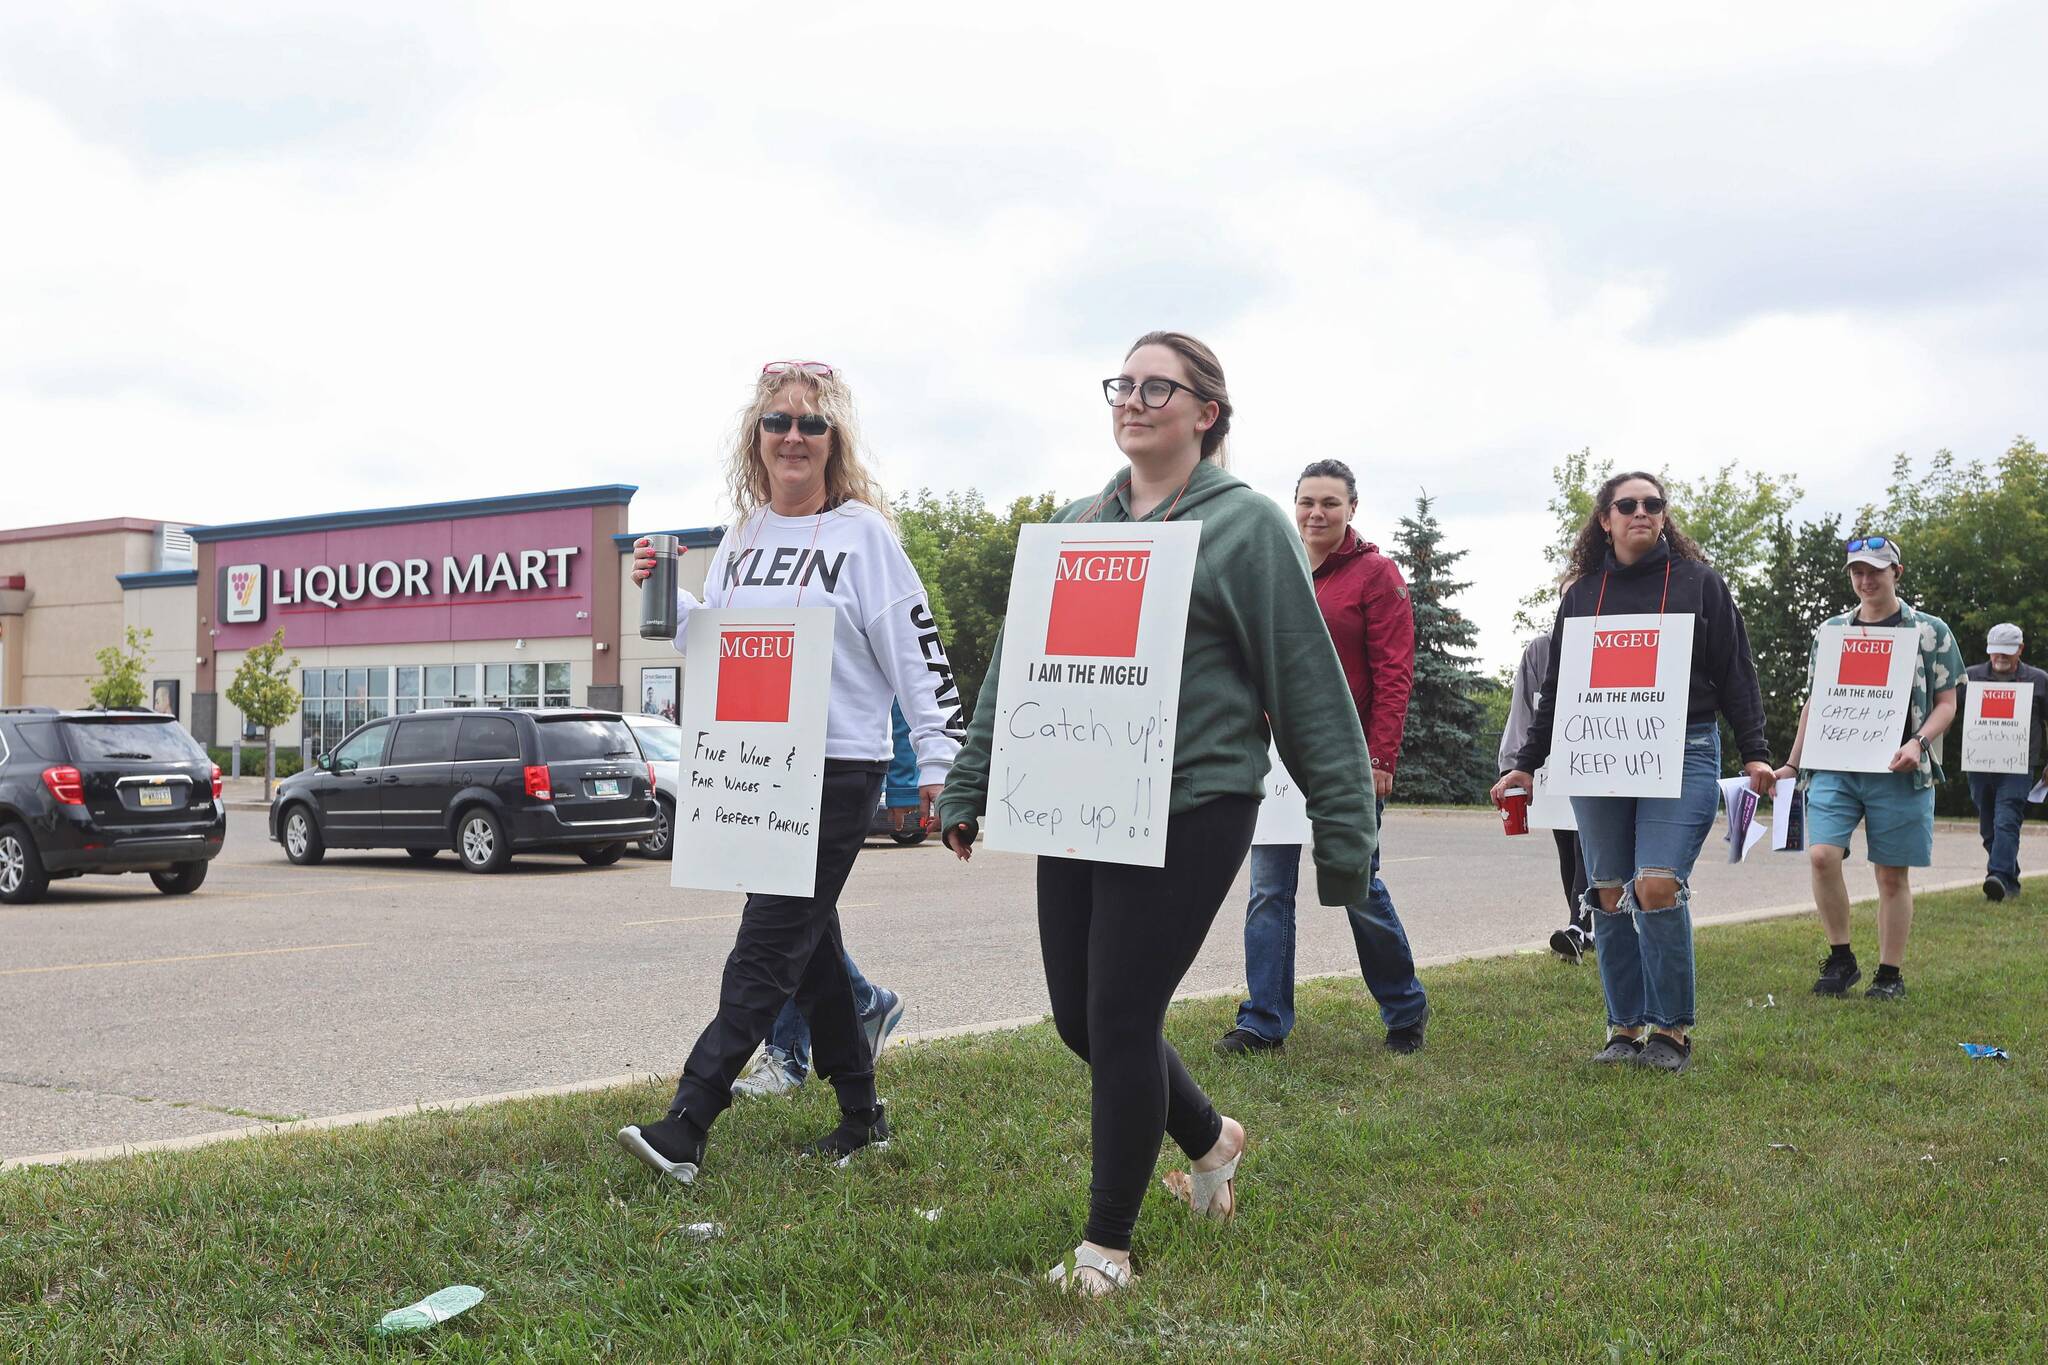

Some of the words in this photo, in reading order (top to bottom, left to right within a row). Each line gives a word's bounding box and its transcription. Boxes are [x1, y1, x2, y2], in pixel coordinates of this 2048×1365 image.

[272, 558, 431, 609] LIQUOR
[442, 546, 579, 595] MART
[722, 547, 847, 594] KLEIN
[1055, 555, 1150, 582] MGEU
[719, 636, 793, 659] MGEU
[1593, 632, 1660, 649] MGEU
[1842, 640, 1894, 654] MGEU
[910, 604, 968, 747] JEAN
[1028, 662, 1034, 682] I
[1037, 663, 1062, 683] AM
[1067, 664, 1096, 684] THE
[1099, 665, 1149, 687] MGEU
[1578, 692, 1582, 703] I
[1585, 692, 1603, 703] AM
[1606, 692, 1627, 703] THE
[1630, 691, 1665, 703] MGEU
[1828, 688, 1831, 696] I
[1833, 688, 1848, 697] AM
[1850, 688, 1866, 698] THE
[1867, 689, 1894, 699] MGEU
[1983, 691, 2016, 700] MGEU
[1009, 701, 1113, 747] Catch
[1821, 705, 1870, 721] CATCH
[1878, 709, 1896, 720] UP
[1564, 715, 1629, 743] CATCH
[1636, 716, 1666, 742] UP
[1820, 724, 1859, 741] KEEP
[1862, 727, 1889, 743] UP!
[1967, 728, 2009, 741] Catch
[694, 731, 728, 761] FINE
[740, 741, 772, 767] WINE
[785, 746, 796, 771] &
[1570, 751, 1618, 777] KEEP
[1625, 750, 1663, 781] UP!
[691, 770, 714, 788] FAIR
[725, 776, 760, 792] WAGES
[1000, 767, 1063, 835] Keep
[692, 807, 700, 822] A
[715, 806, 760, 826] PERFECT
[768, 811, 809, 836] PAIRING
